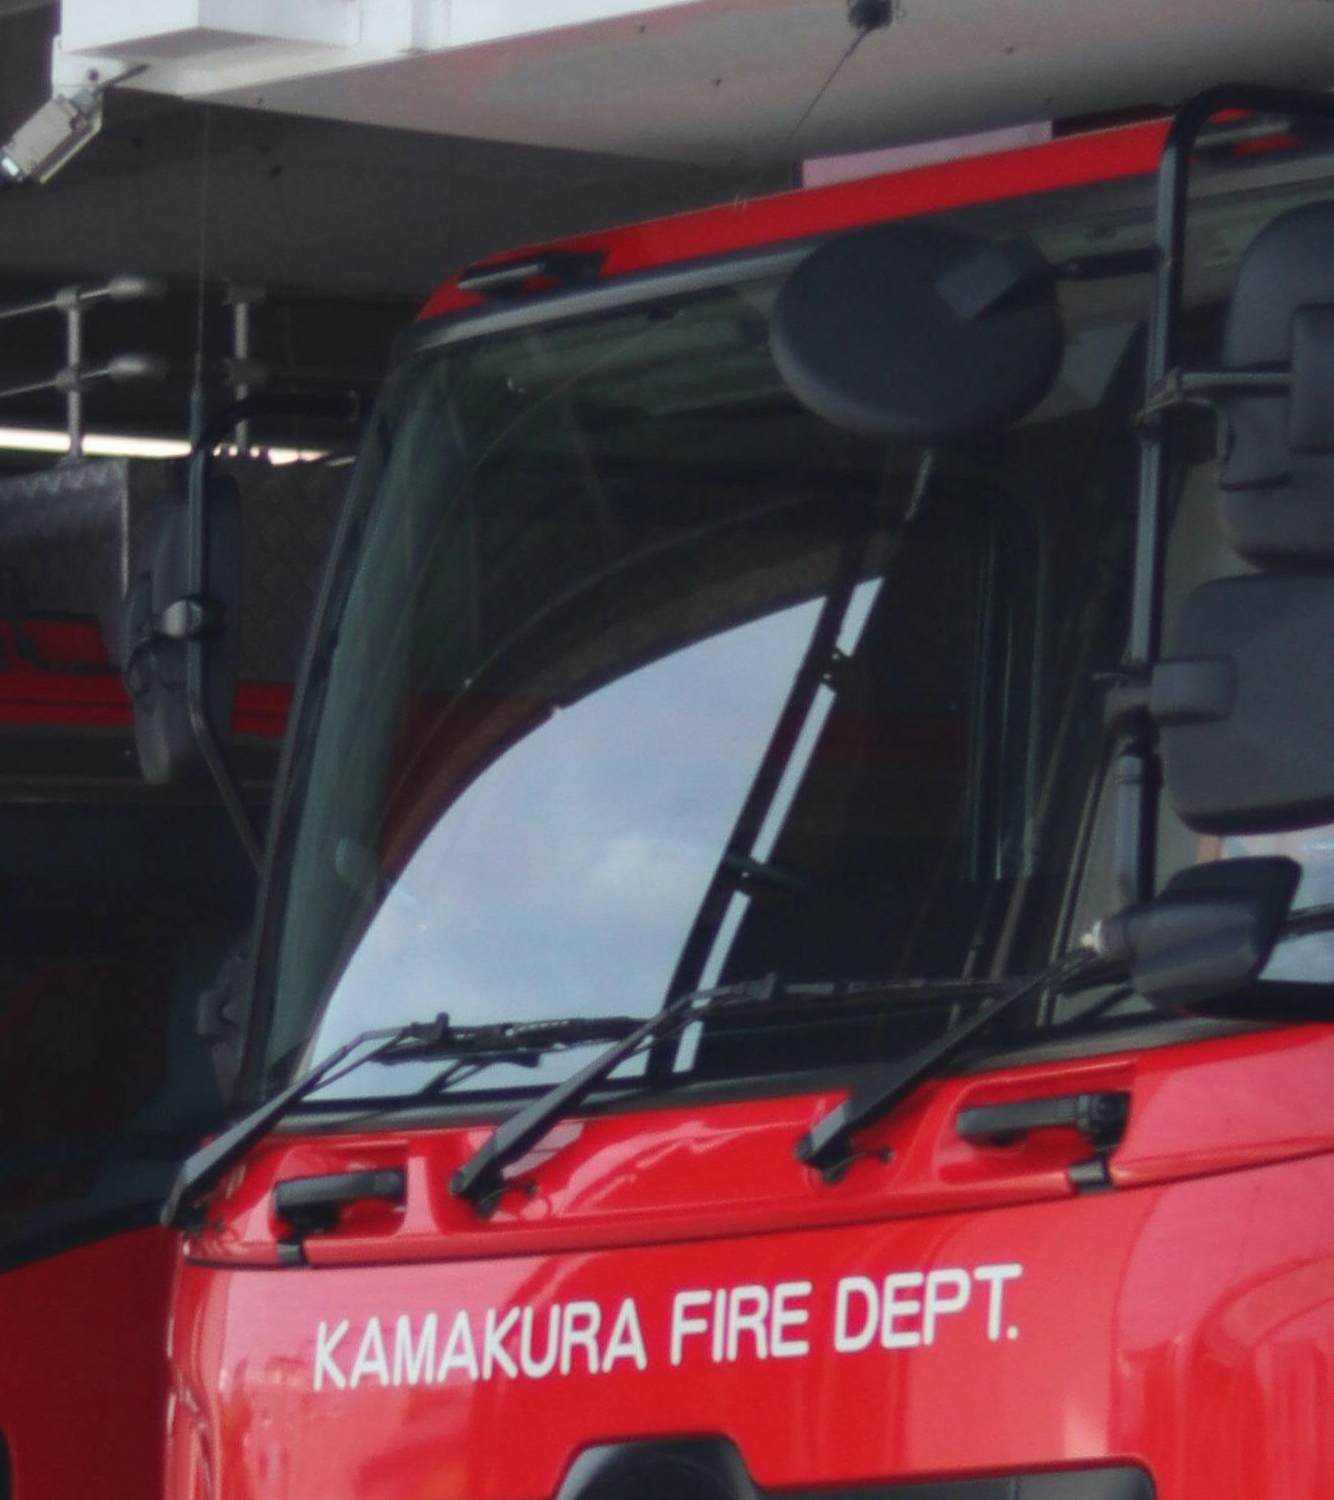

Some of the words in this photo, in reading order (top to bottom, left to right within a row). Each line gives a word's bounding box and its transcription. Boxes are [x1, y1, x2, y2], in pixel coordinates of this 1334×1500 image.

[313, 1296, 648, 1391] KAMAKURA
[670, 1280, 813, 1366] FIRE
[833, 1263, 1023, 1353] DEPT.
